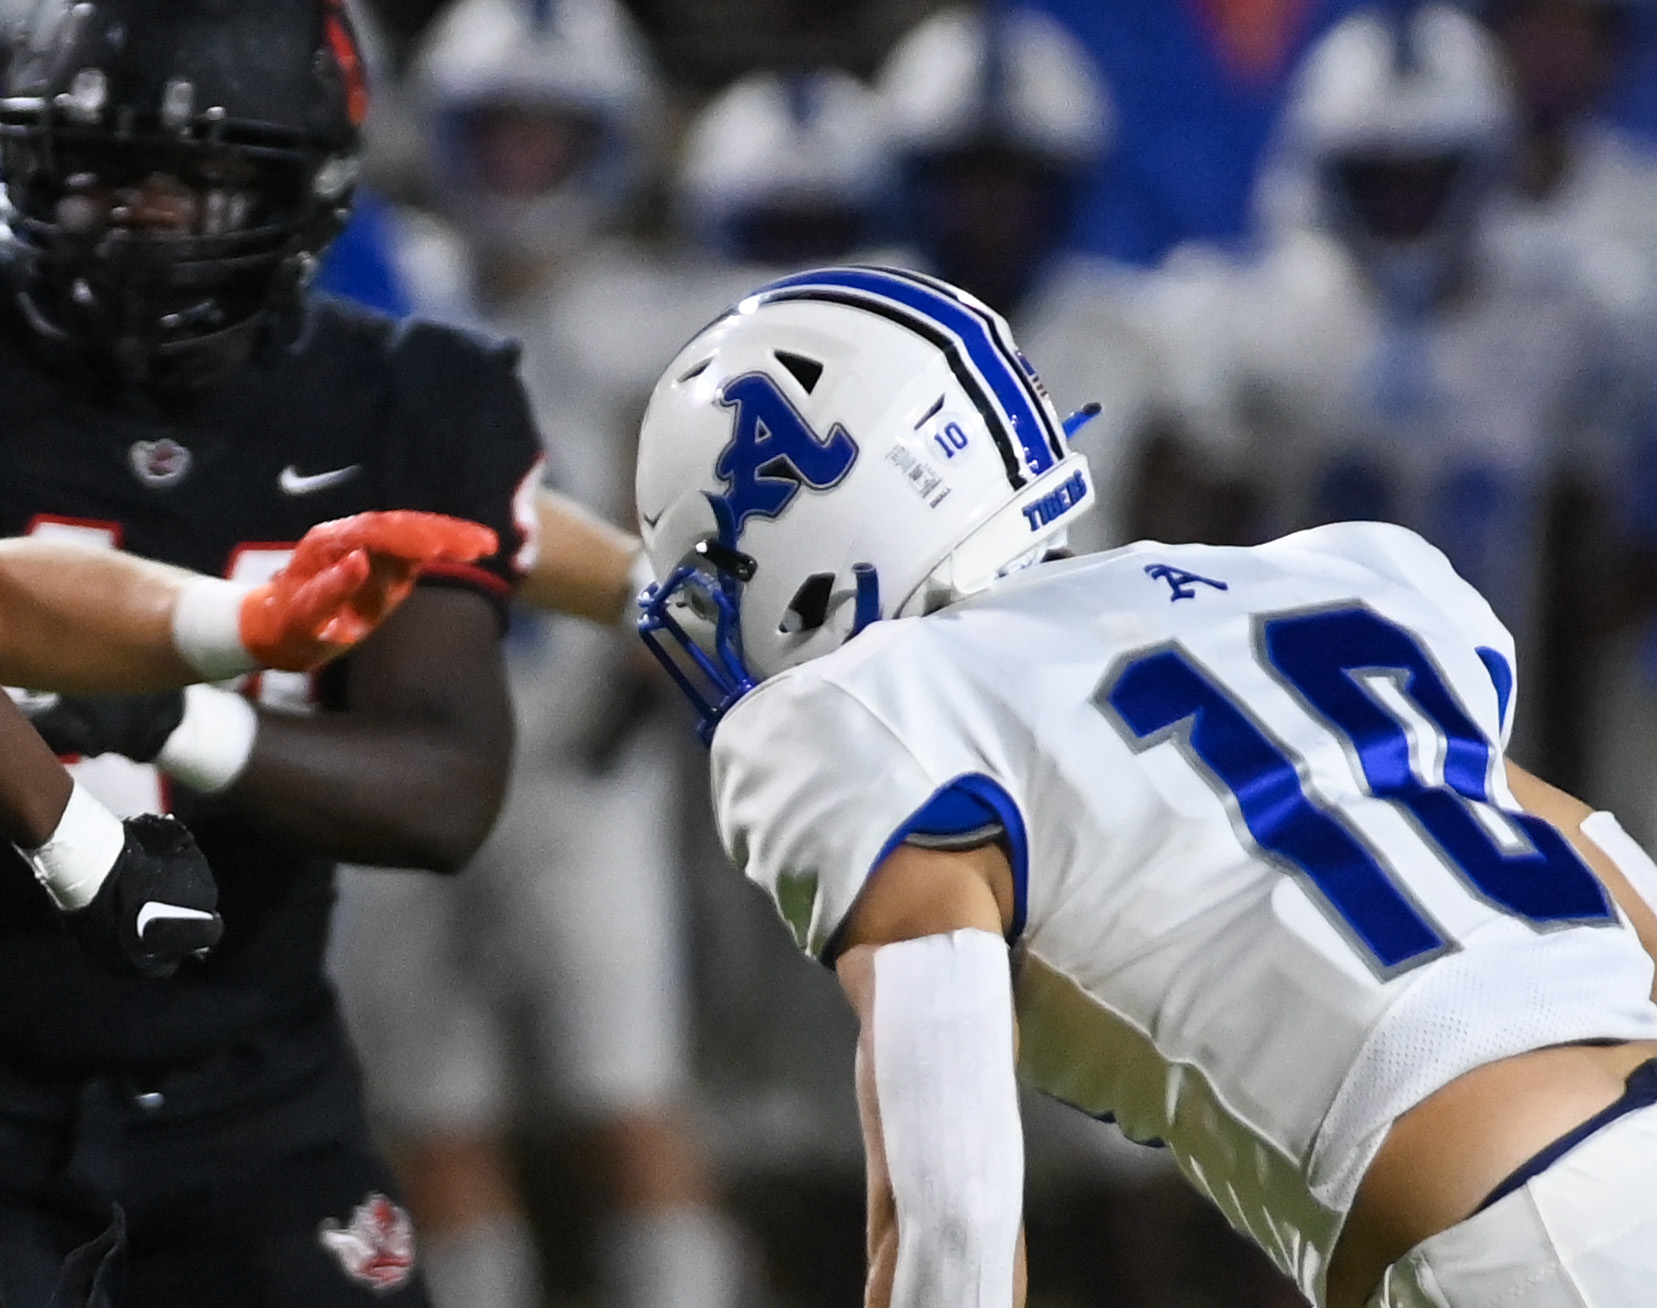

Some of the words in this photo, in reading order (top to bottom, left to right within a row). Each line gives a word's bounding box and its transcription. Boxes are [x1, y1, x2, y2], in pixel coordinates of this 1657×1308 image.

[713, 369, 860, 535] A
[933, 420, 969, 459] 10
[1021, 468, 1088, 532] TIGERS
[1145, 563, 1228, 603] A
[1090, 597, 1622, 983] 10
